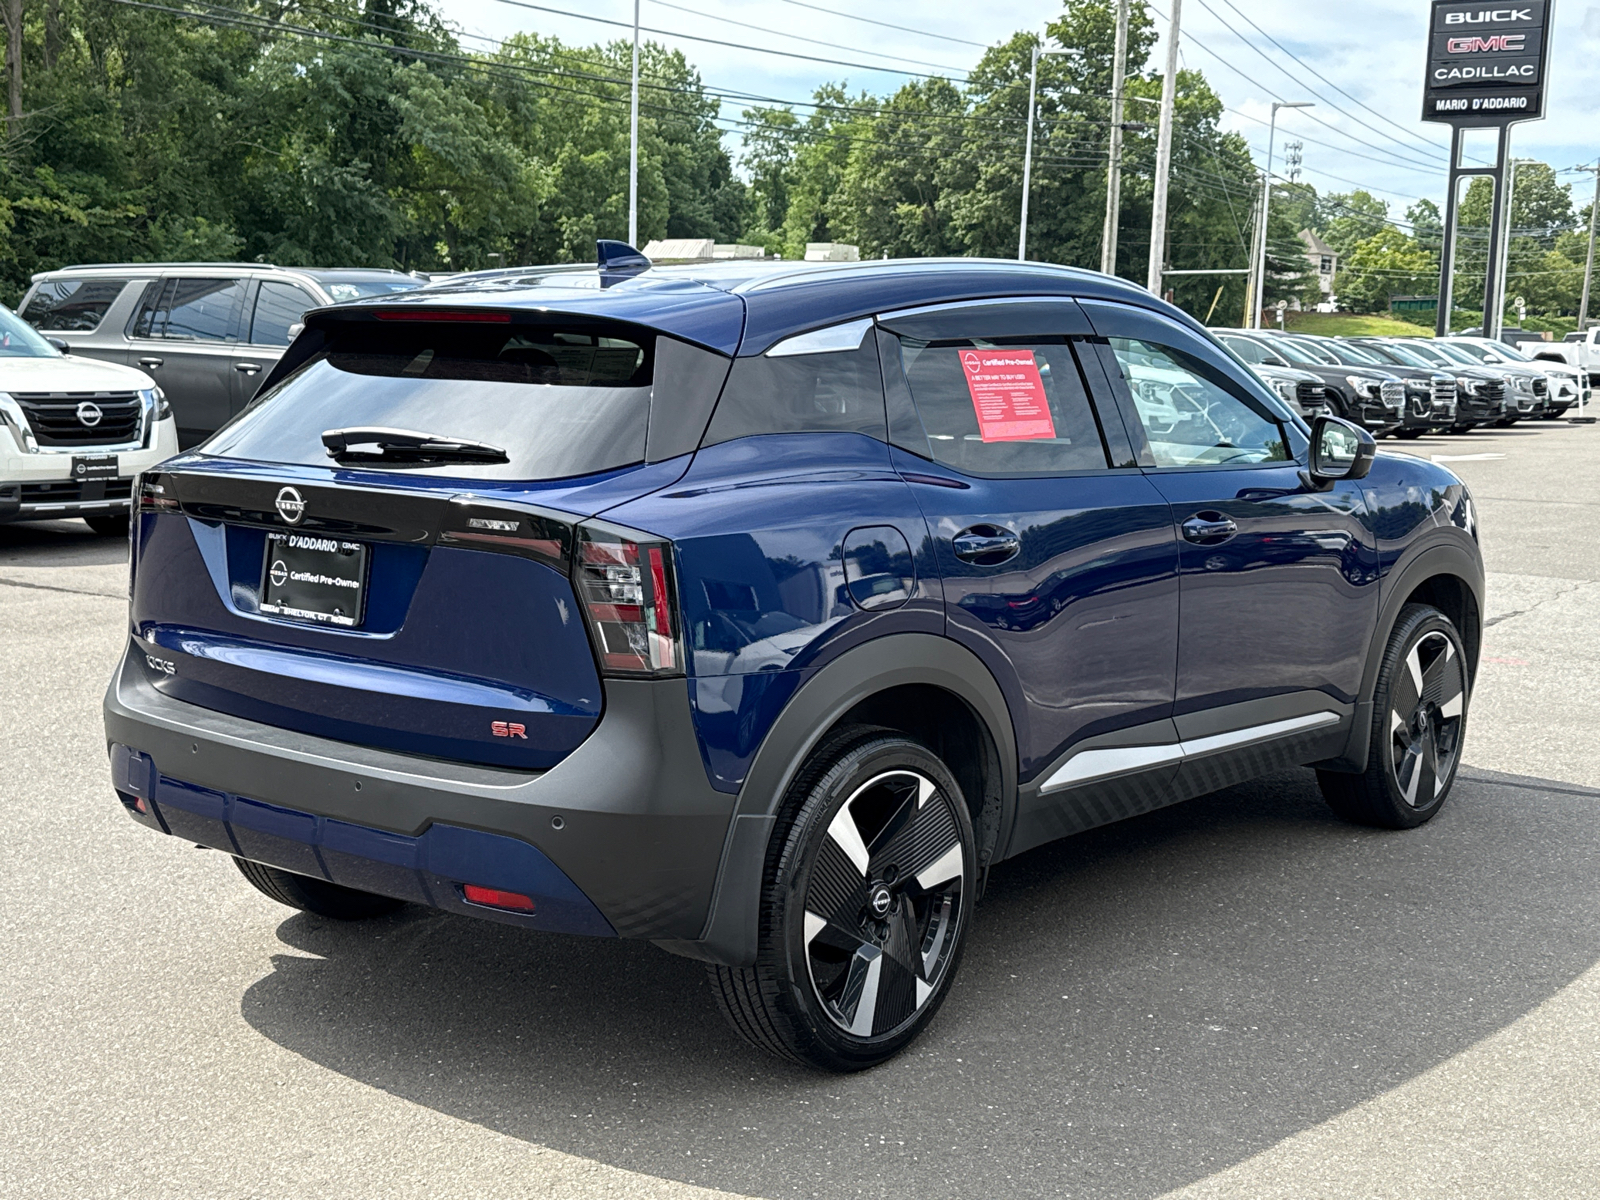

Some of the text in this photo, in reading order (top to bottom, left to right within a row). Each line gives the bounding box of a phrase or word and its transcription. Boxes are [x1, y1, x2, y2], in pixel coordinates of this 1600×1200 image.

[1445, 8, 1532, 24] BUICK
[1447, 34, 1525, 54] GMC
[1434, 65, 1534, 79] CADILLAC
[1436, 97, 1527, 111] MARIO D'ADDARIO
[982, 358, 1034, 366] Certified Pre-Owned
[268, 532, 361, 553] BUICK D'ADDARIO GMC
[290, 570, 320, 583] Certified
[491, 720, 529, 740] SR
